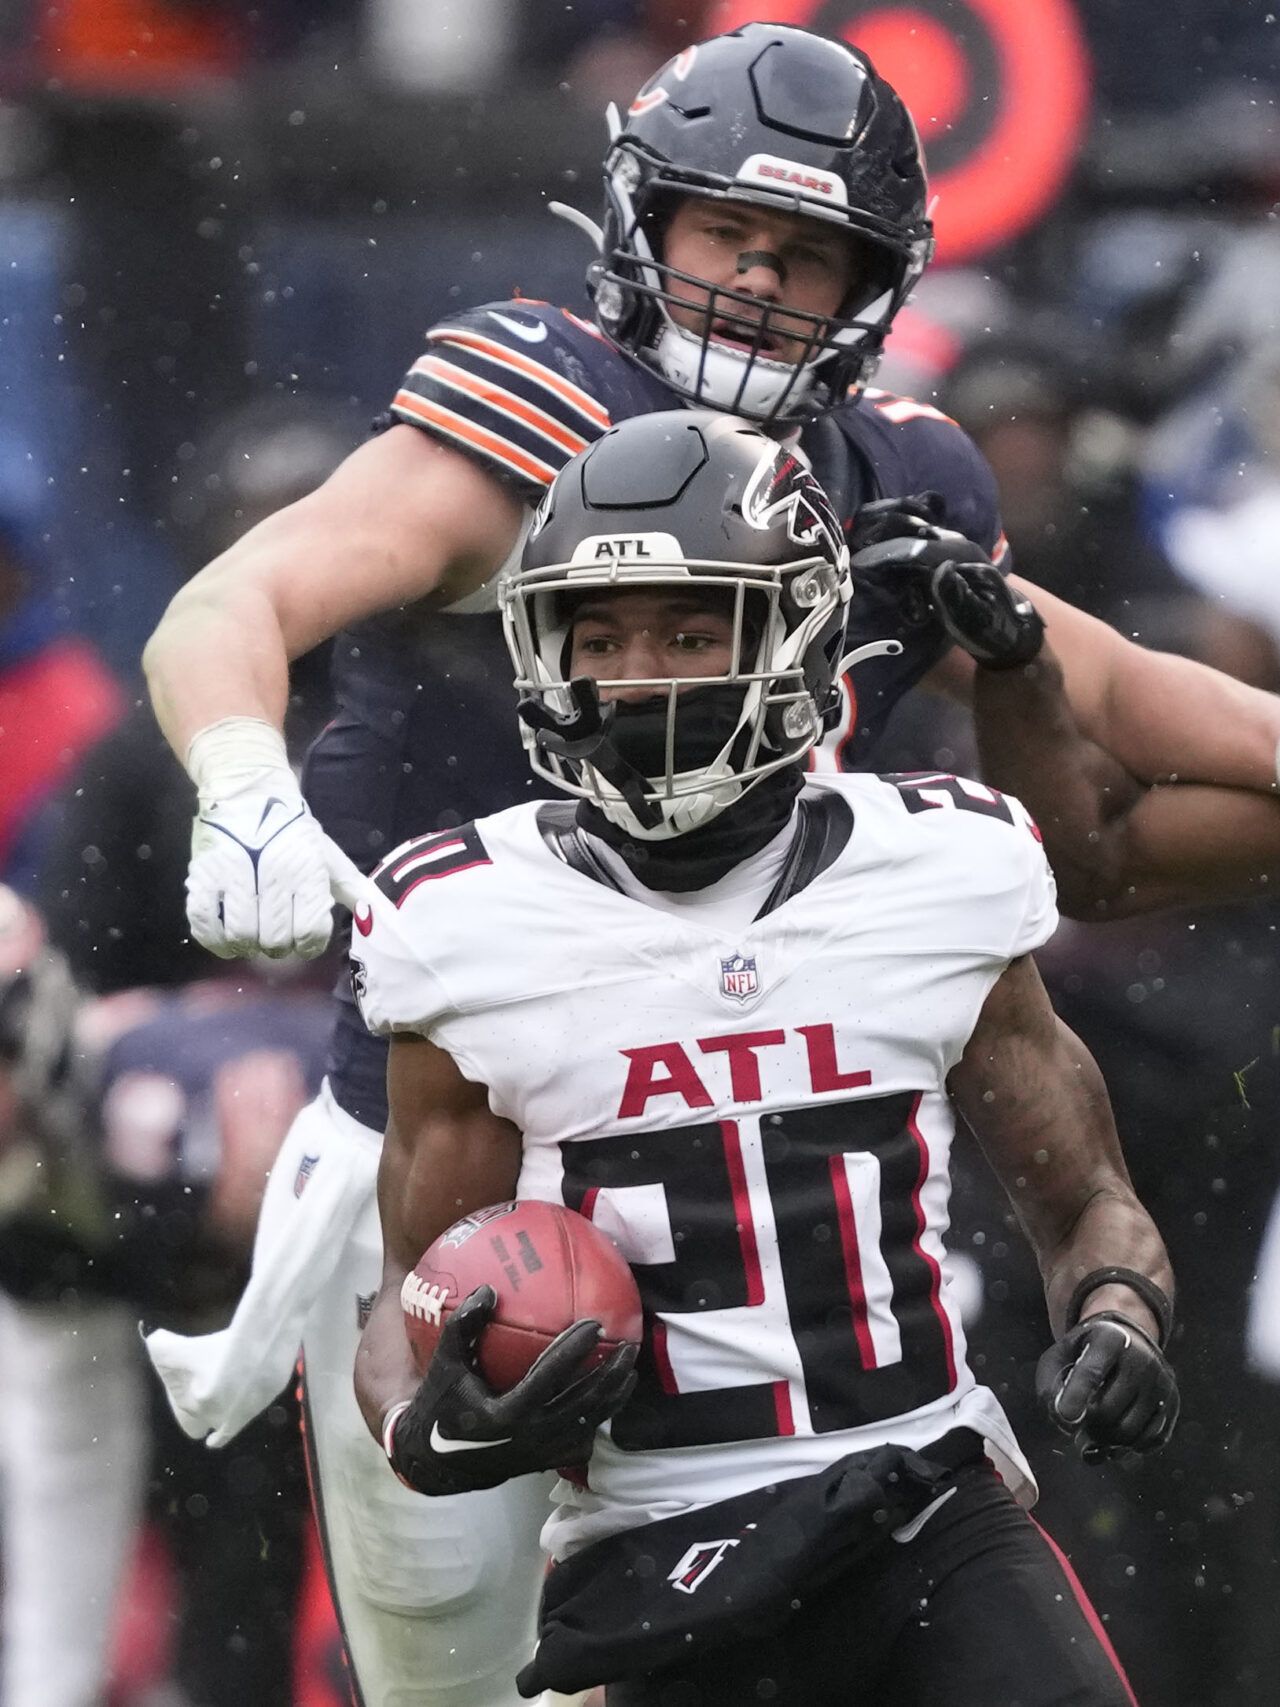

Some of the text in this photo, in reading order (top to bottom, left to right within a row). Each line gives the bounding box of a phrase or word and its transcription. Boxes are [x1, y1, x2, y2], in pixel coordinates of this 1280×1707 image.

[758, 163, 833, 194] BEARS
[595, 540, 650, 558] ATL
[725, 973, 756, 994] NFL
[617, 1022, 873, 1119] ATL
[560, 1091, 957, 1452] 20
